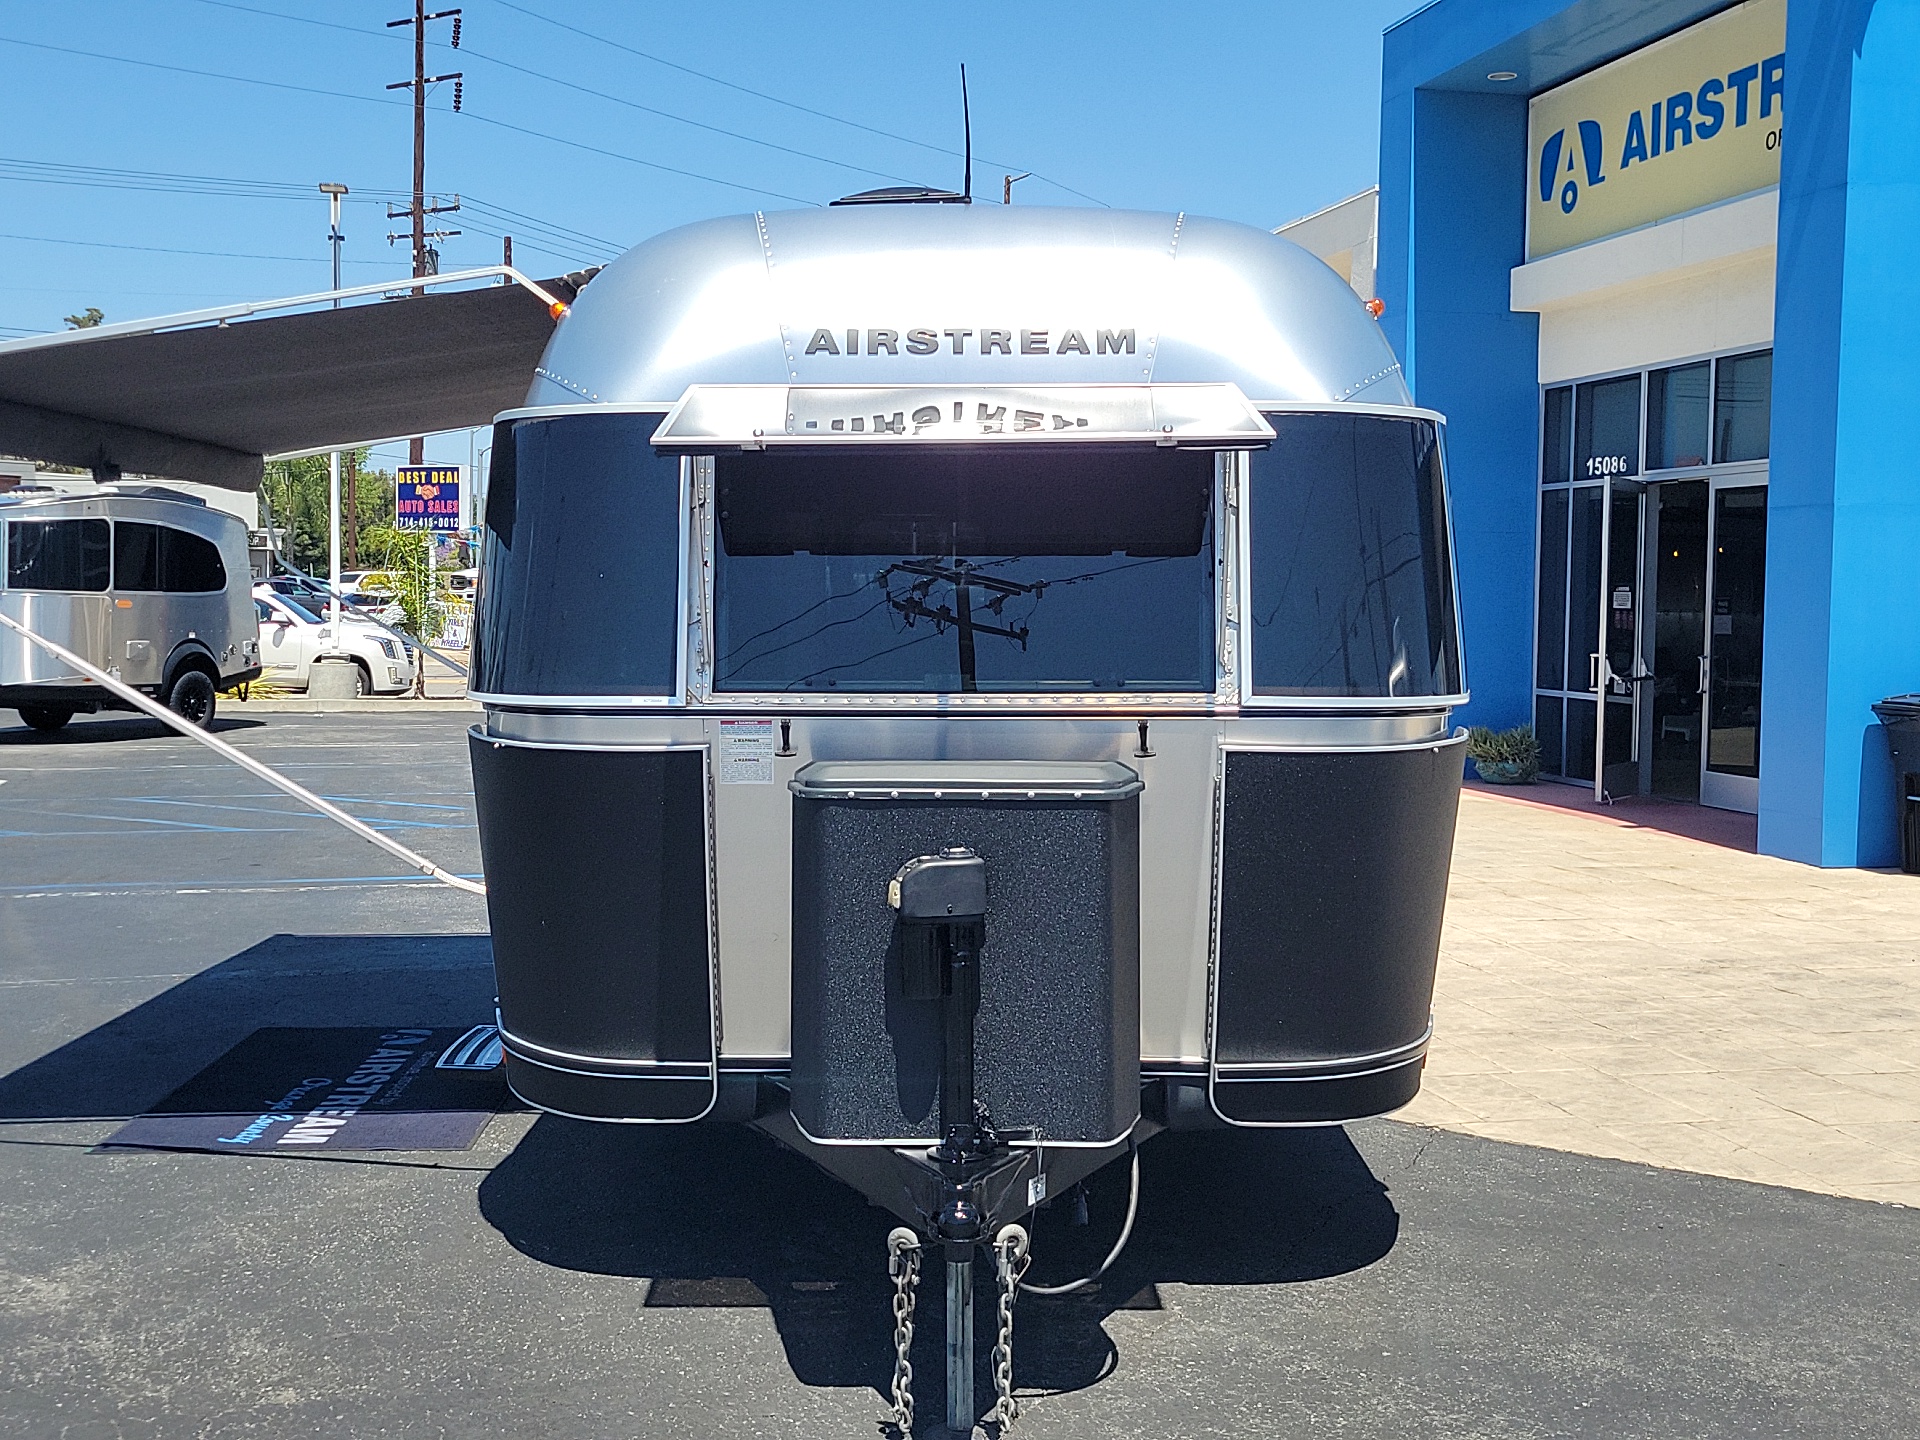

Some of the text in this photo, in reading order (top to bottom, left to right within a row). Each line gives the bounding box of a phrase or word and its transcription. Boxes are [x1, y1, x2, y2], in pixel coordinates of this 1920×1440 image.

[1620, 53, 1785, 170] AIRSTR
[805, 328, 1136, 355] AIRSTREAM
[398, 471, 459, 484] BEST DEAL
[1586, 456, 1627, 476] 15086
[398, 500, 459, 513] AUTO SALES
[276, 1047, 415, 1145] AIRSTREAM
[217, 1112, 295, 1145] County
